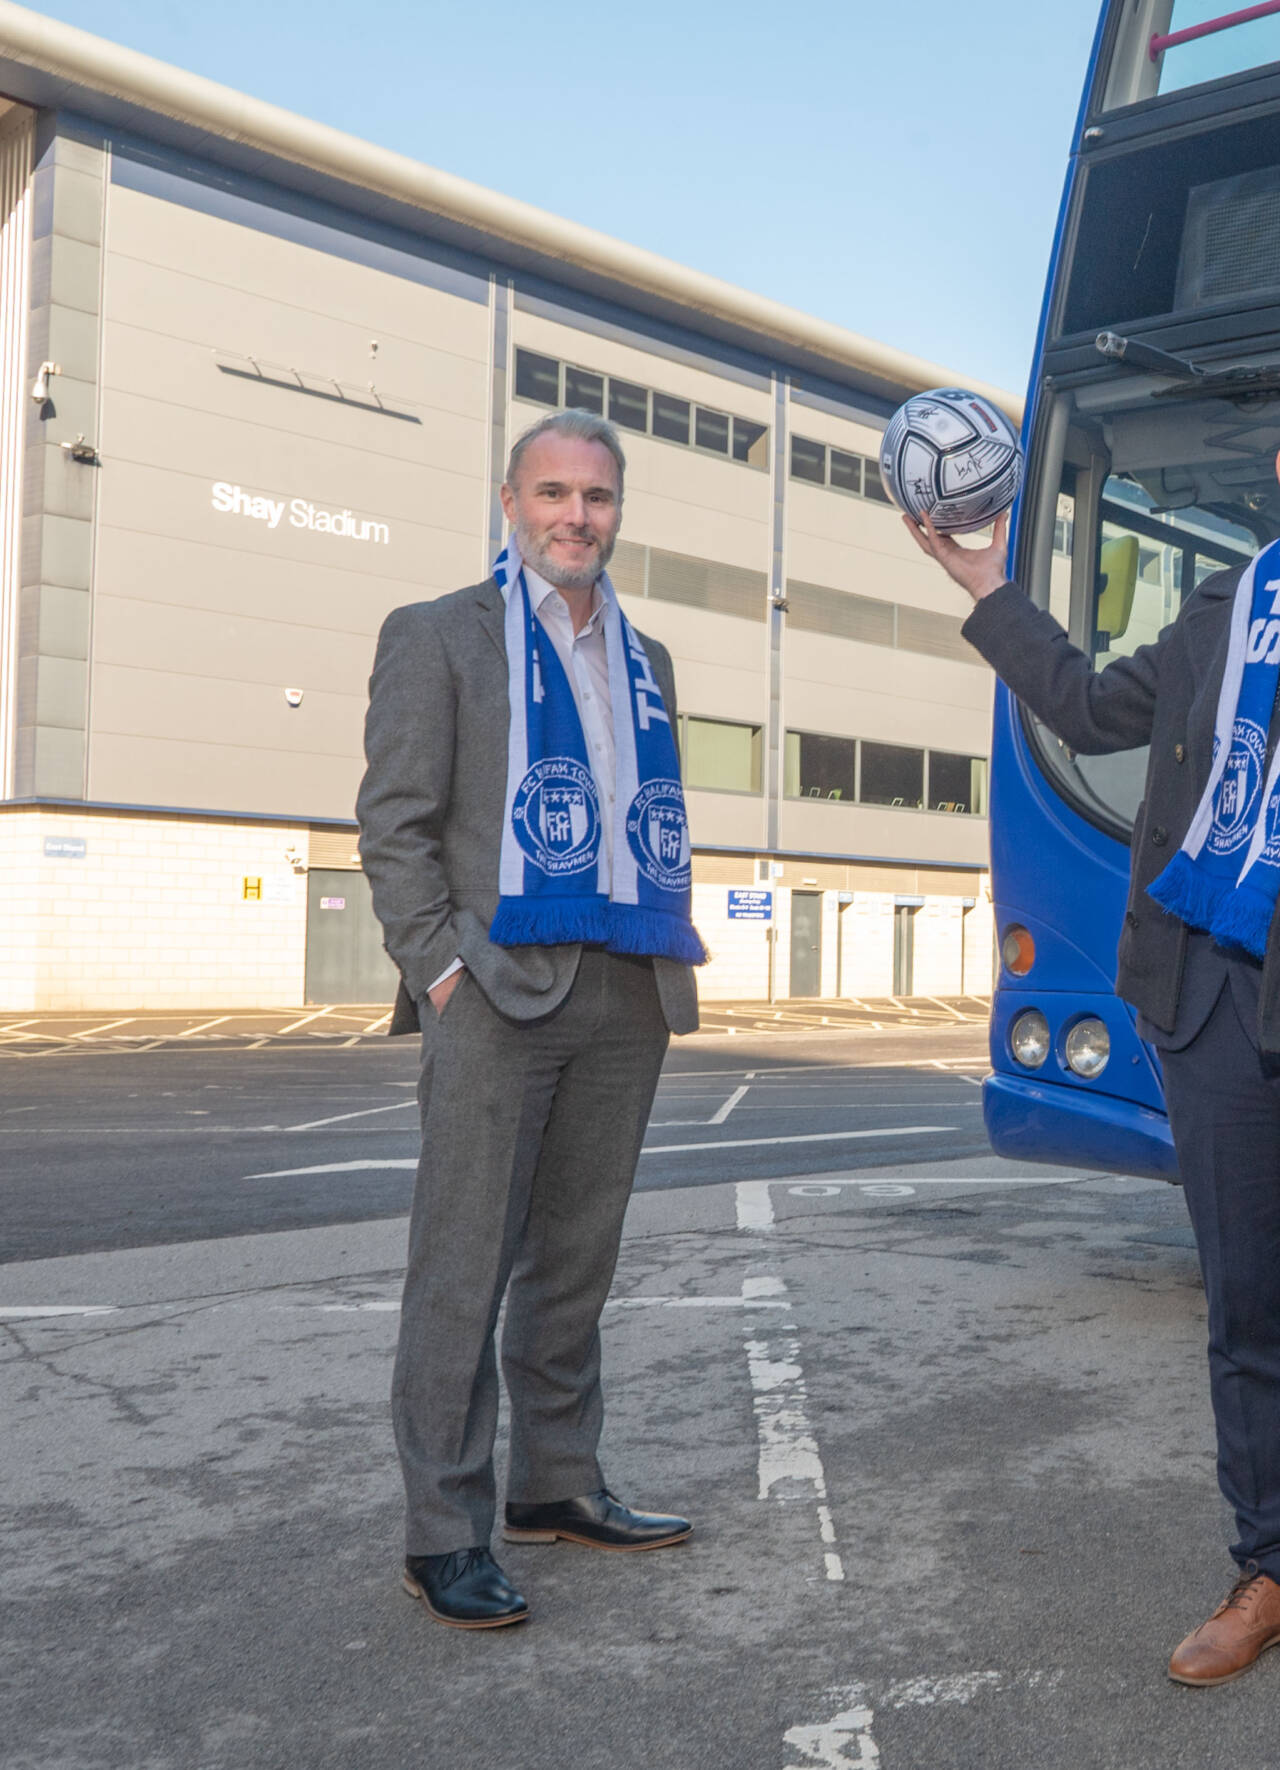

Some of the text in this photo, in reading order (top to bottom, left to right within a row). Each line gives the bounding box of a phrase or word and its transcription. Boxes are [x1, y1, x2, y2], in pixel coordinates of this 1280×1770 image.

[211, 481, 390, 545] Shay Stadium
[659, 873, 691, 889] SHAYME
